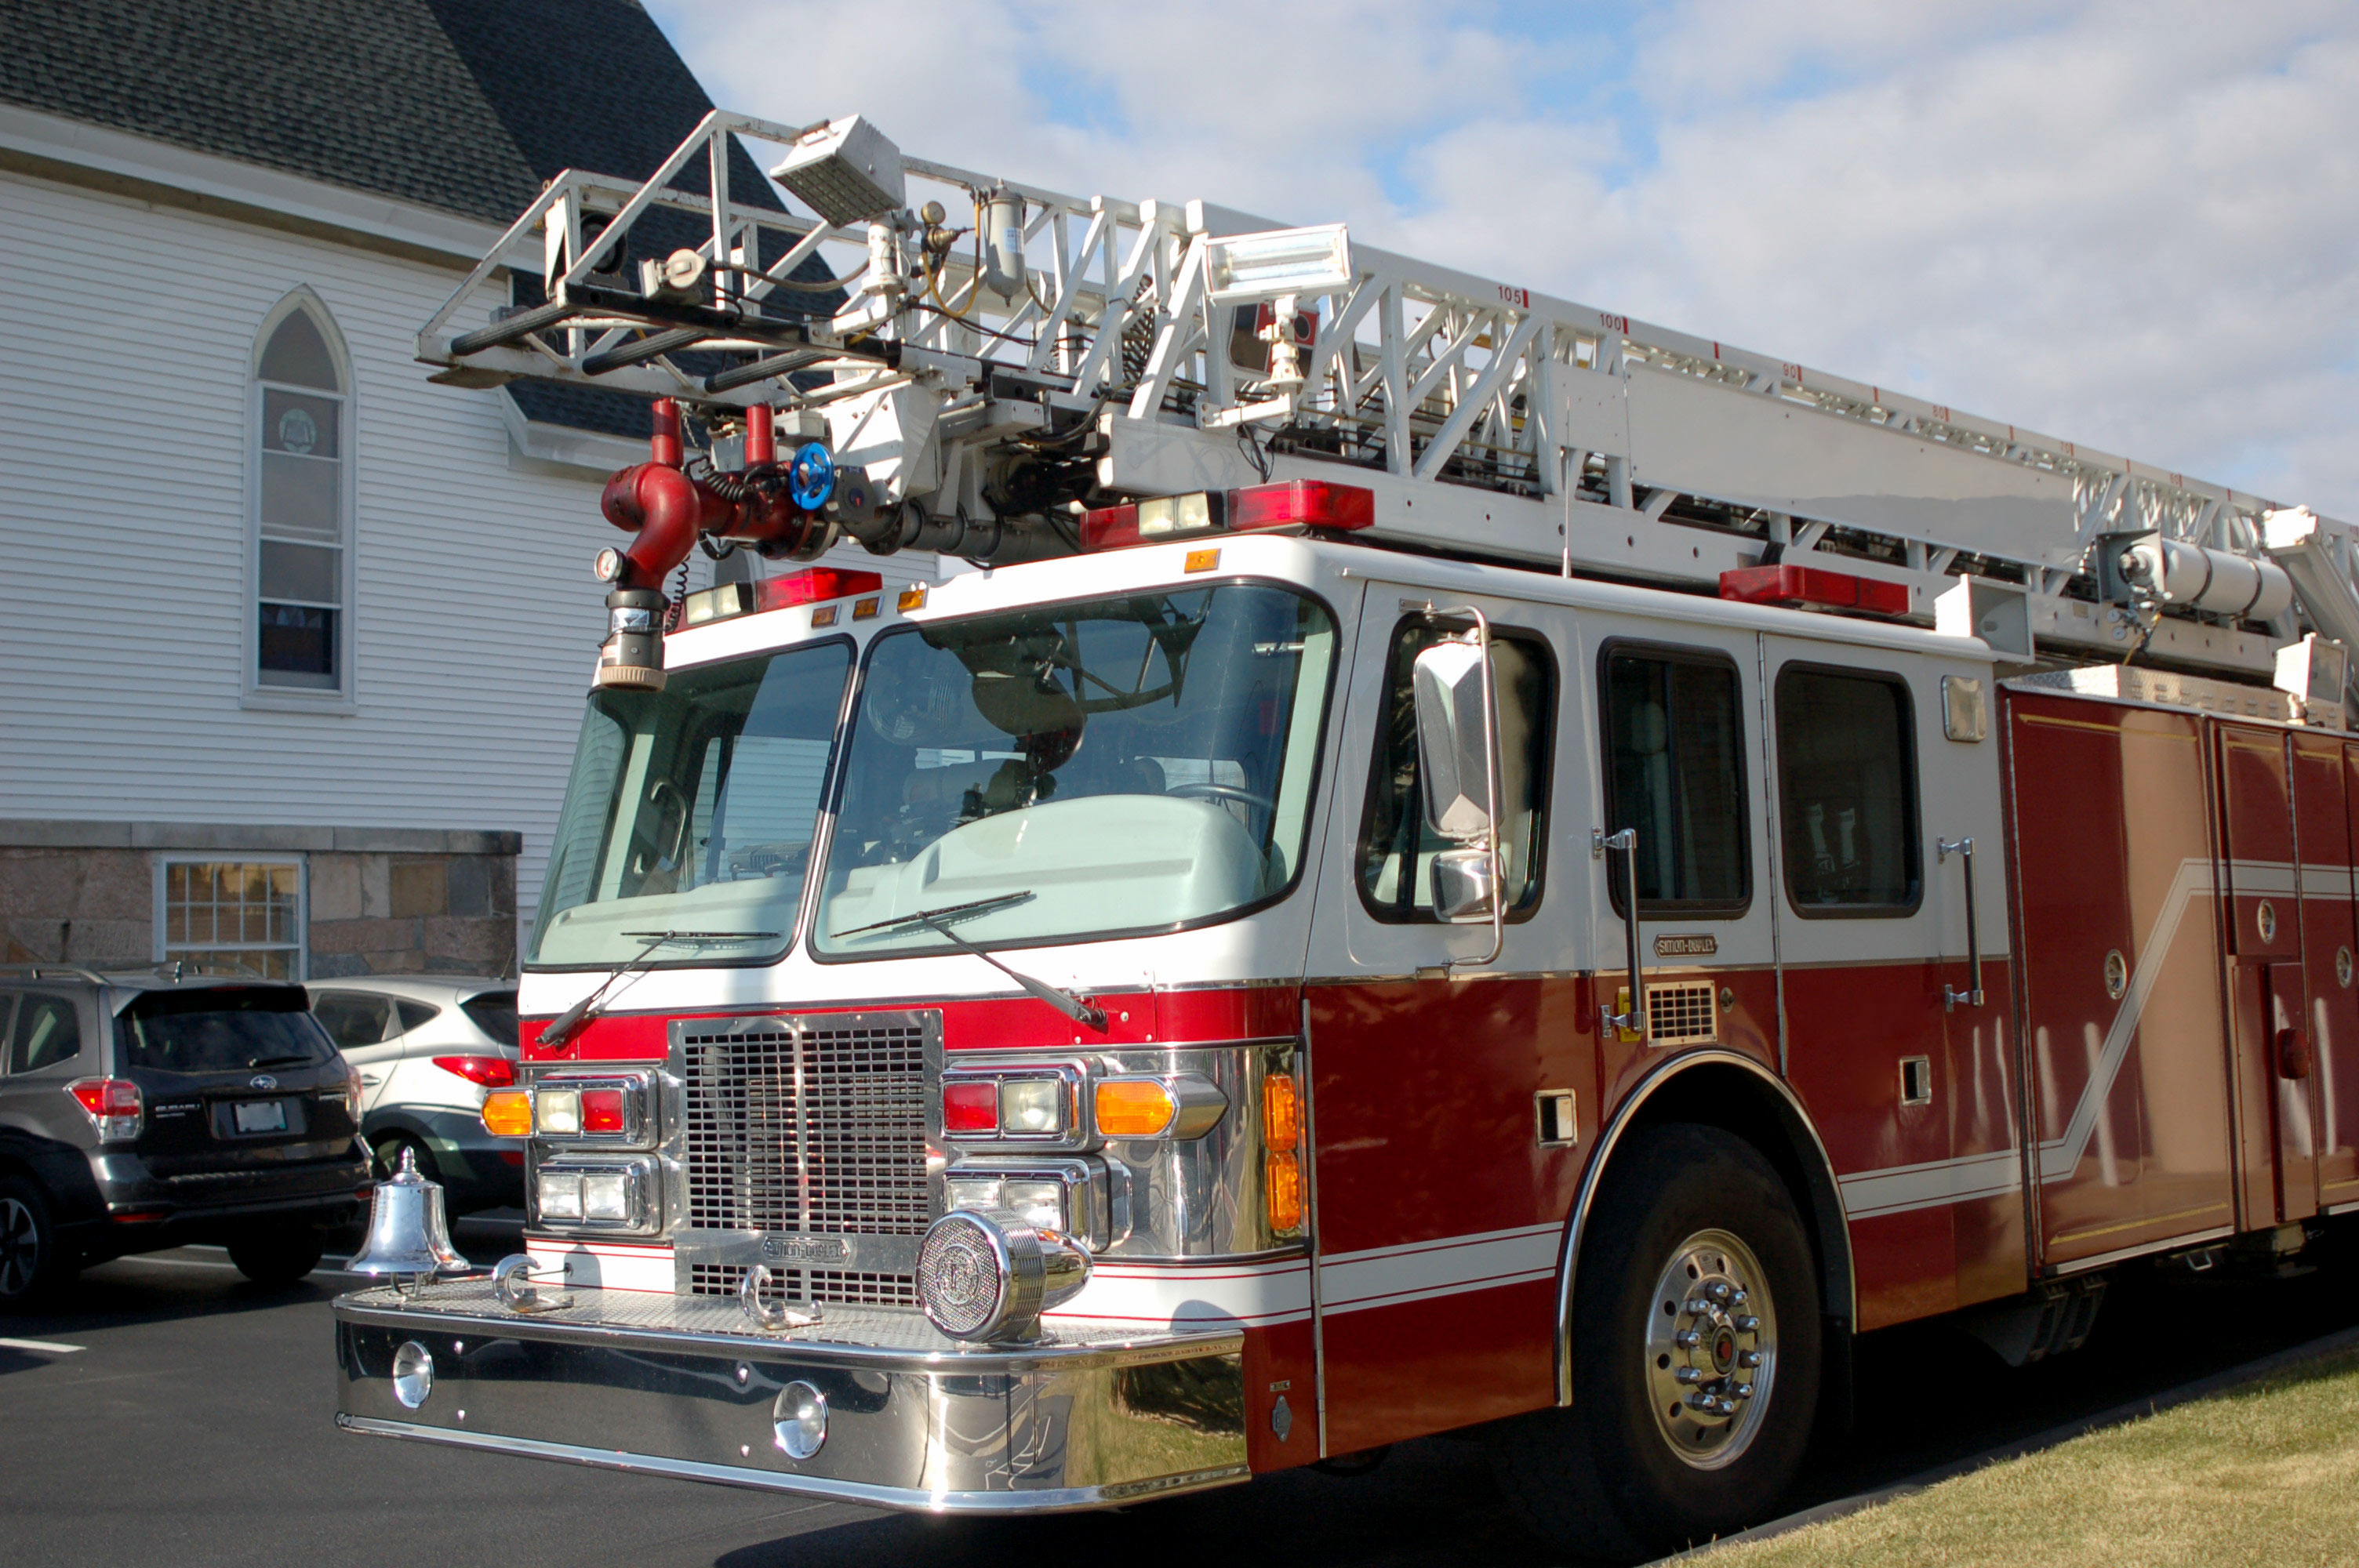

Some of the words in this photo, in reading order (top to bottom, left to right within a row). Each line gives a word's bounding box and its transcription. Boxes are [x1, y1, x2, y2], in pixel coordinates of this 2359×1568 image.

[1498, 285, 1521, 304] 105
[1600, 313, 1621, 331] 100
[1783, 363, 1797, 379] 90
[1658, 938, 1715, 953] SIMON-DUPLEX
